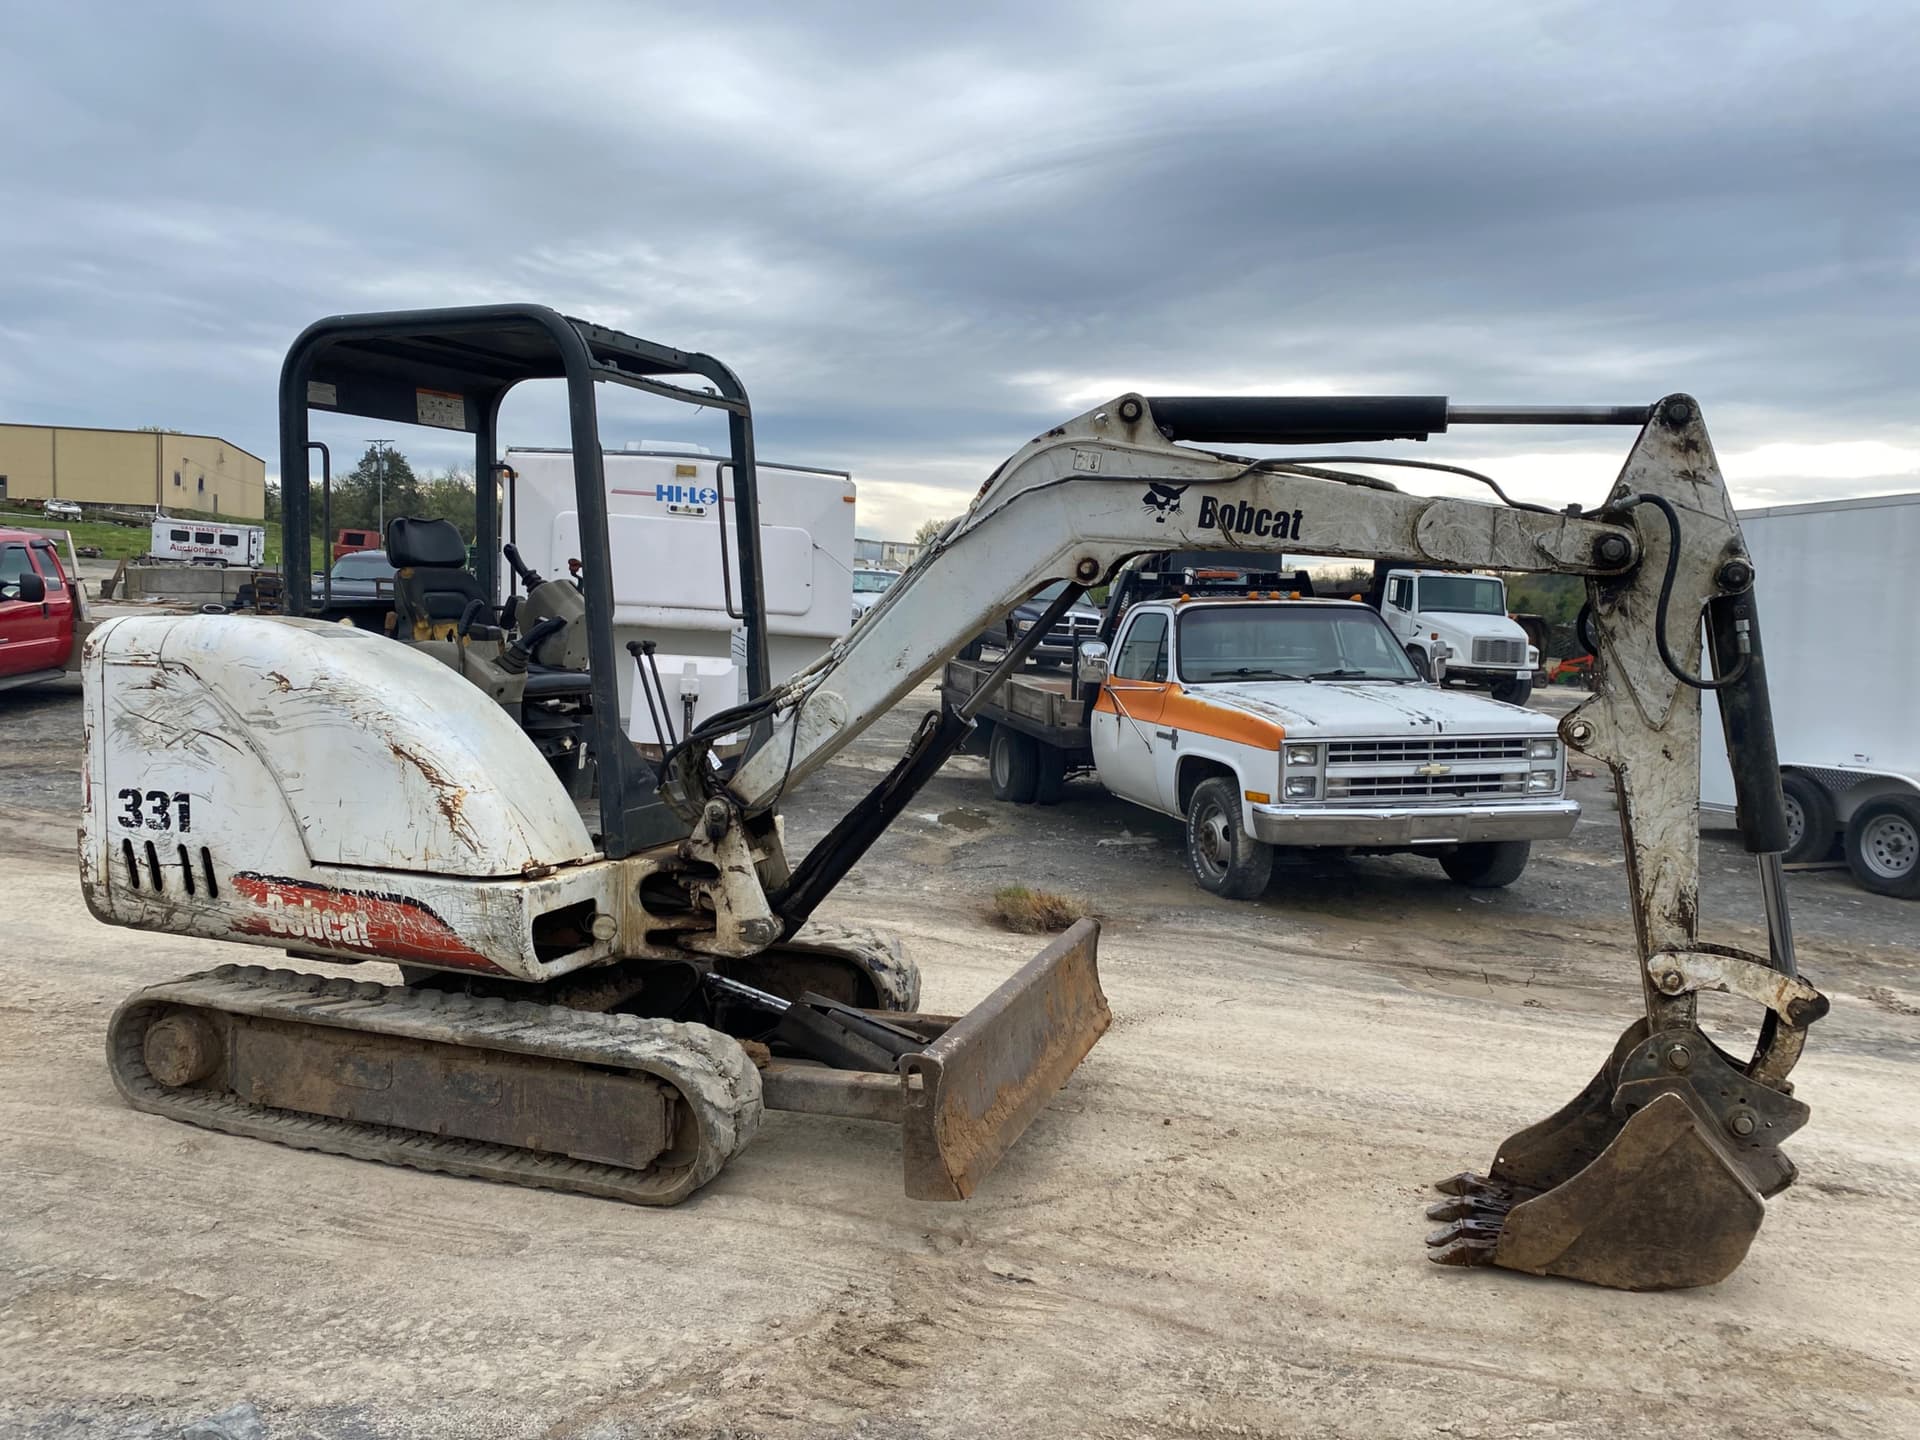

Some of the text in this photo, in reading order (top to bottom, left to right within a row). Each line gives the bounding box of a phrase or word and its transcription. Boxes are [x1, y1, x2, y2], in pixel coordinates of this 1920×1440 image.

[1198, 495, 1304, 541] Bobcat
[170, 544, 223, 554] Auctioneers
[118, 788, 191, 833] 331
[264, 892, 373, 948] Bobcat
